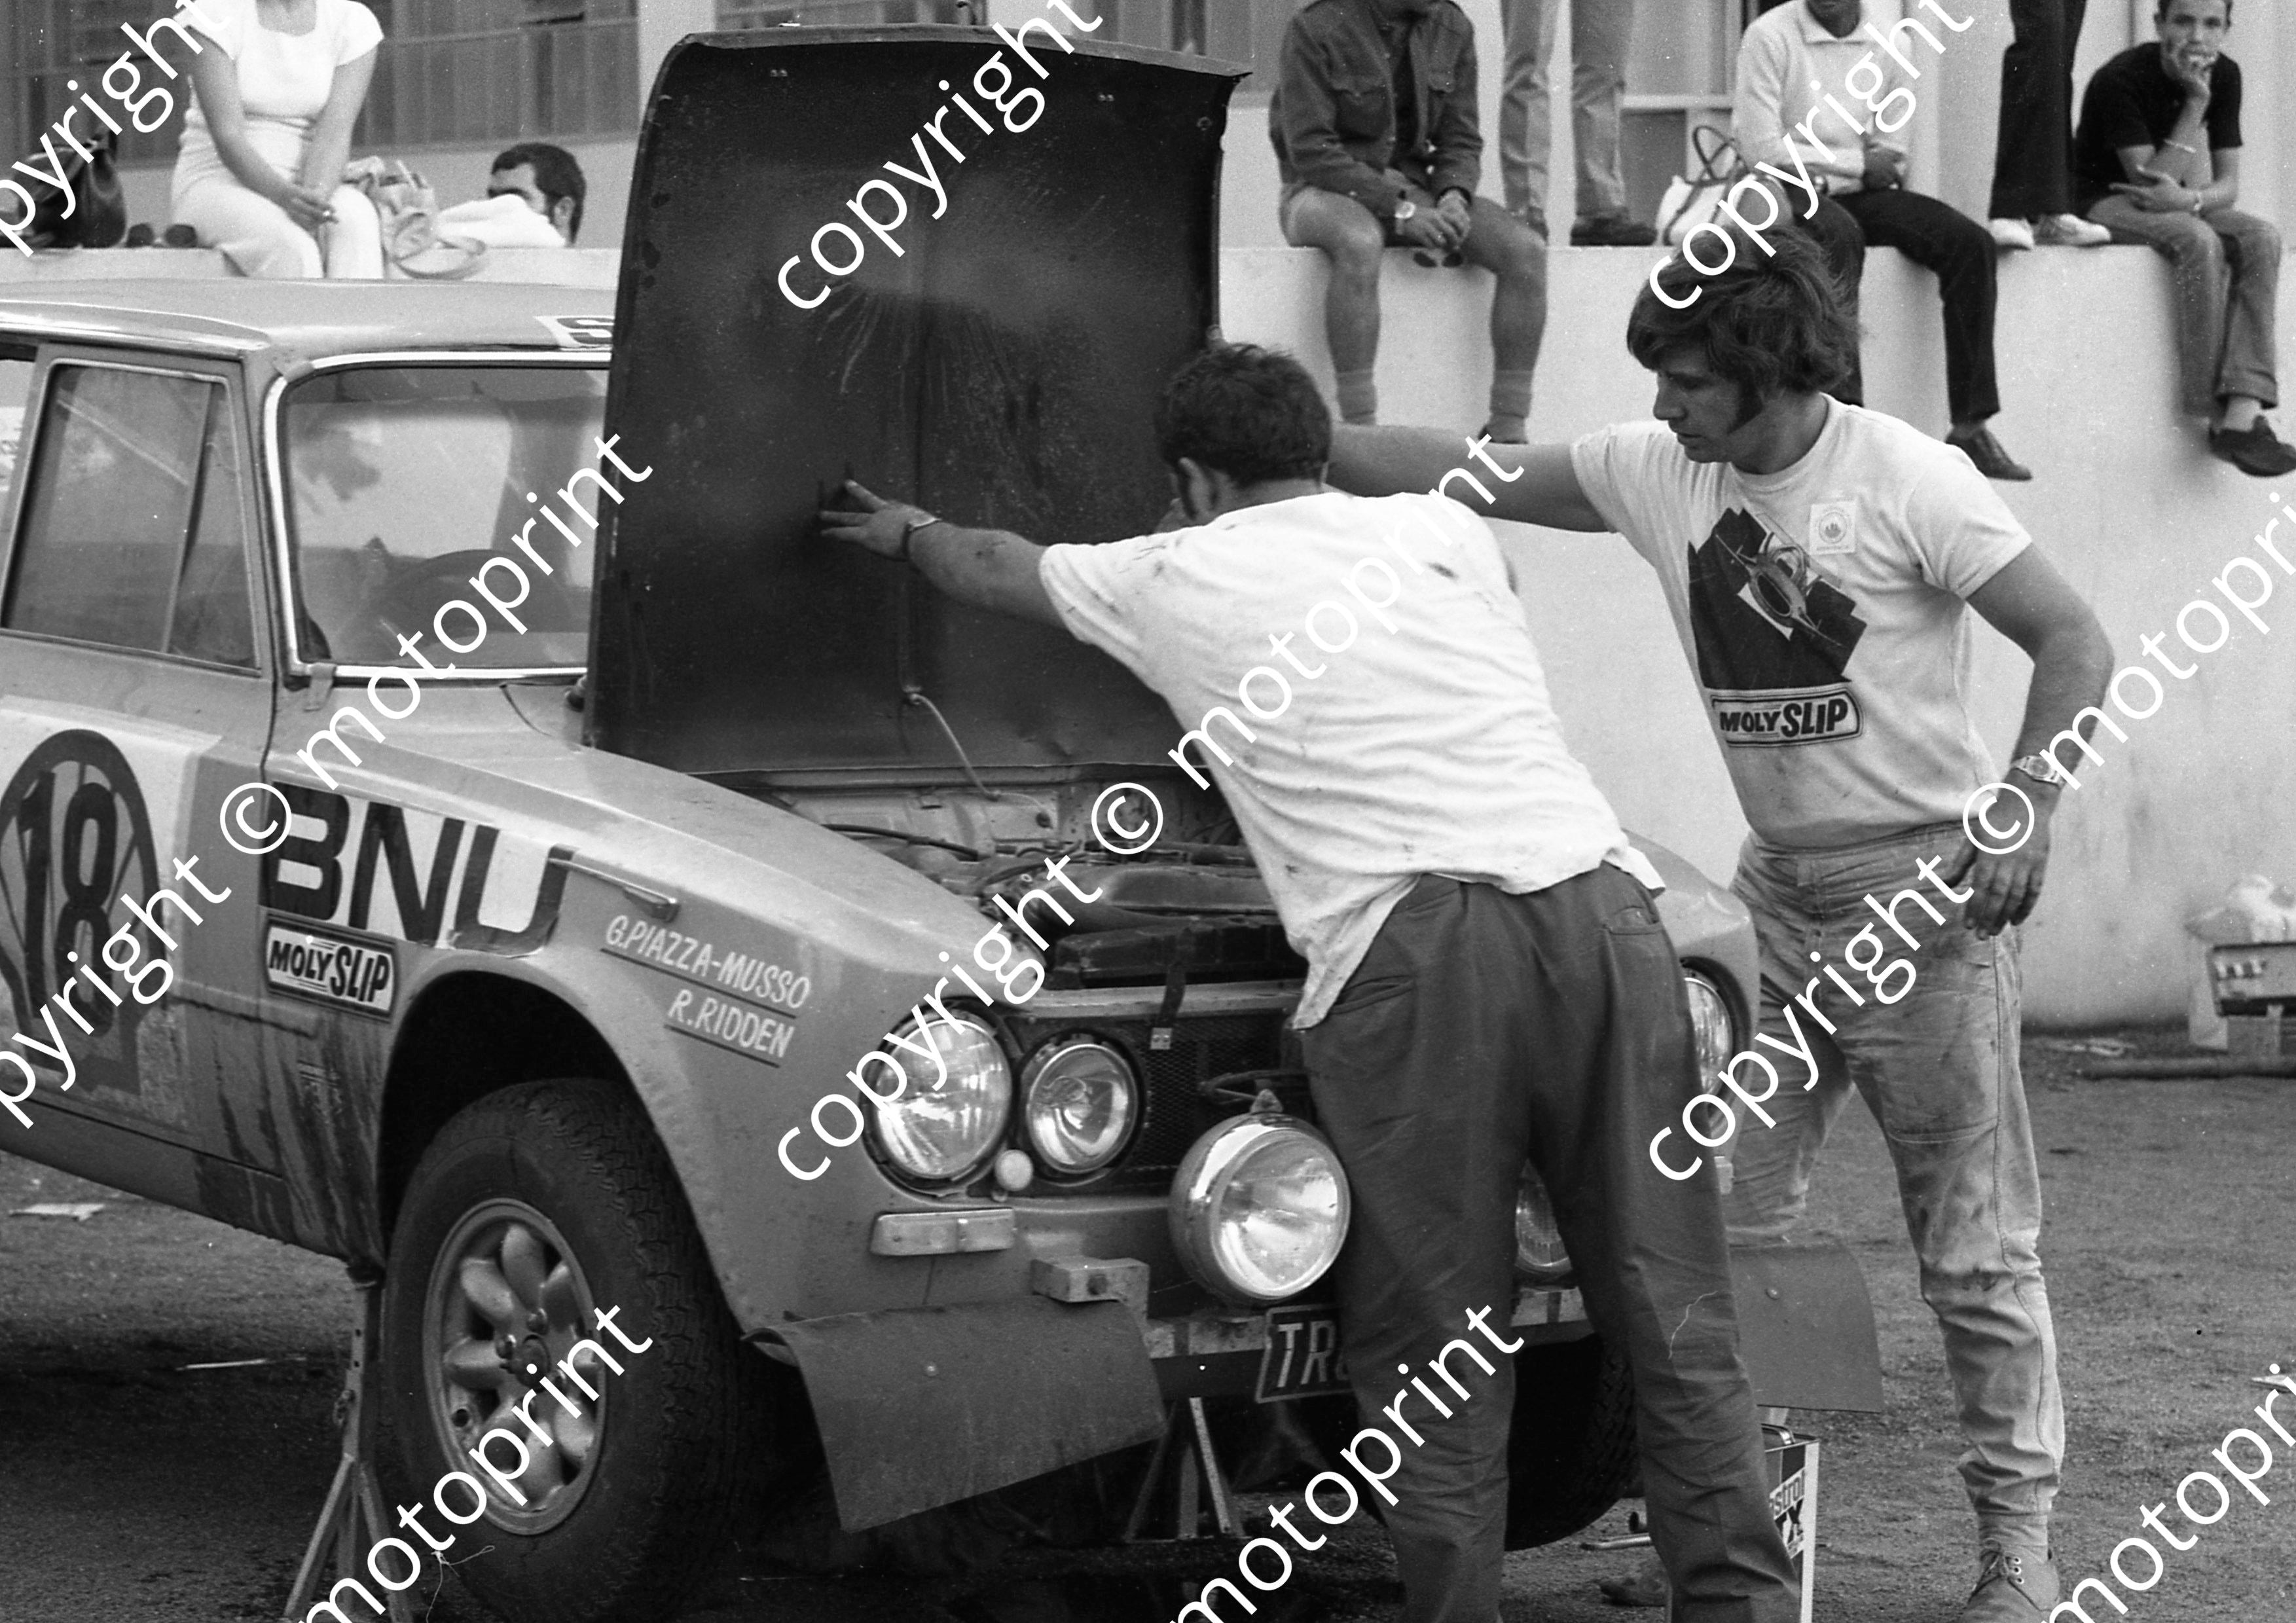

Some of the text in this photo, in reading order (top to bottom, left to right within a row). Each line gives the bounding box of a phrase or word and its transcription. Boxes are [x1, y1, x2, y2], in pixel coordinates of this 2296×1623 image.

[1719, 698, 1849, 738] MOLYSLIP
[20, 771, 117, 1037] 18
[259, 781, 575, 953] BNU
[268, 939, 391, 1002] MOLYSLIP
